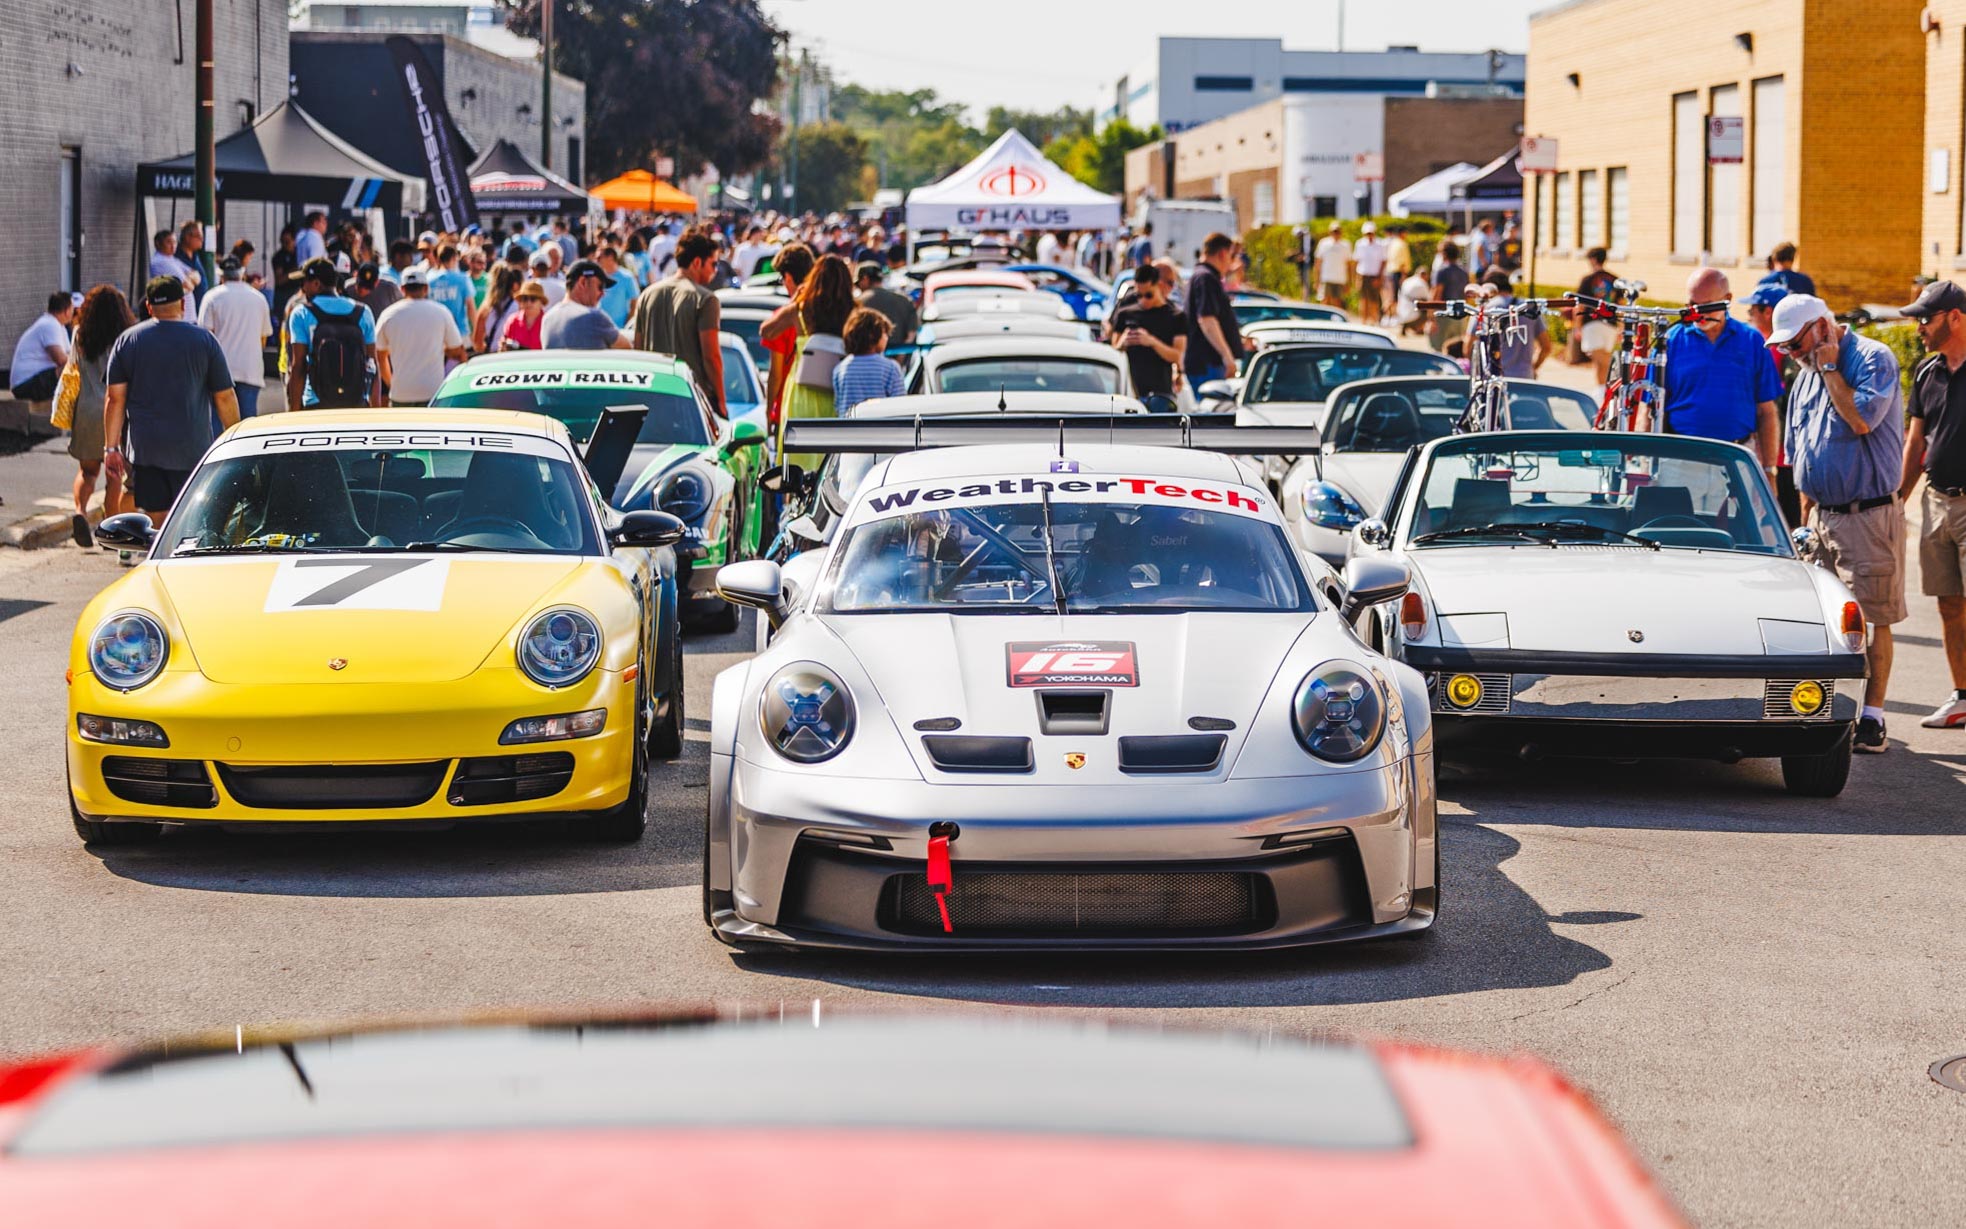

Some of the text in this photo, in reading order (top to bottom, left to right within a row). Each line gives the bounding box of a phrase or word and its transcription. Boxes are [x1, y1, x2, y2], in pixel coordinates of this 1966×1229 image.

[405, 62, 457, 234] PORSCHE
[154, 174, 224, 192] HAGEY
[475, 373, 649, 387] CROWN RALLY
[263, 435, 514, 450] PORSCHE
[1056, 461, 1073, 472] 1
[291, 557, 435, 607] 7
[1018, 652, 1126, 673] 16
[1044, 675, 1129, 683] YOKOHAMA
